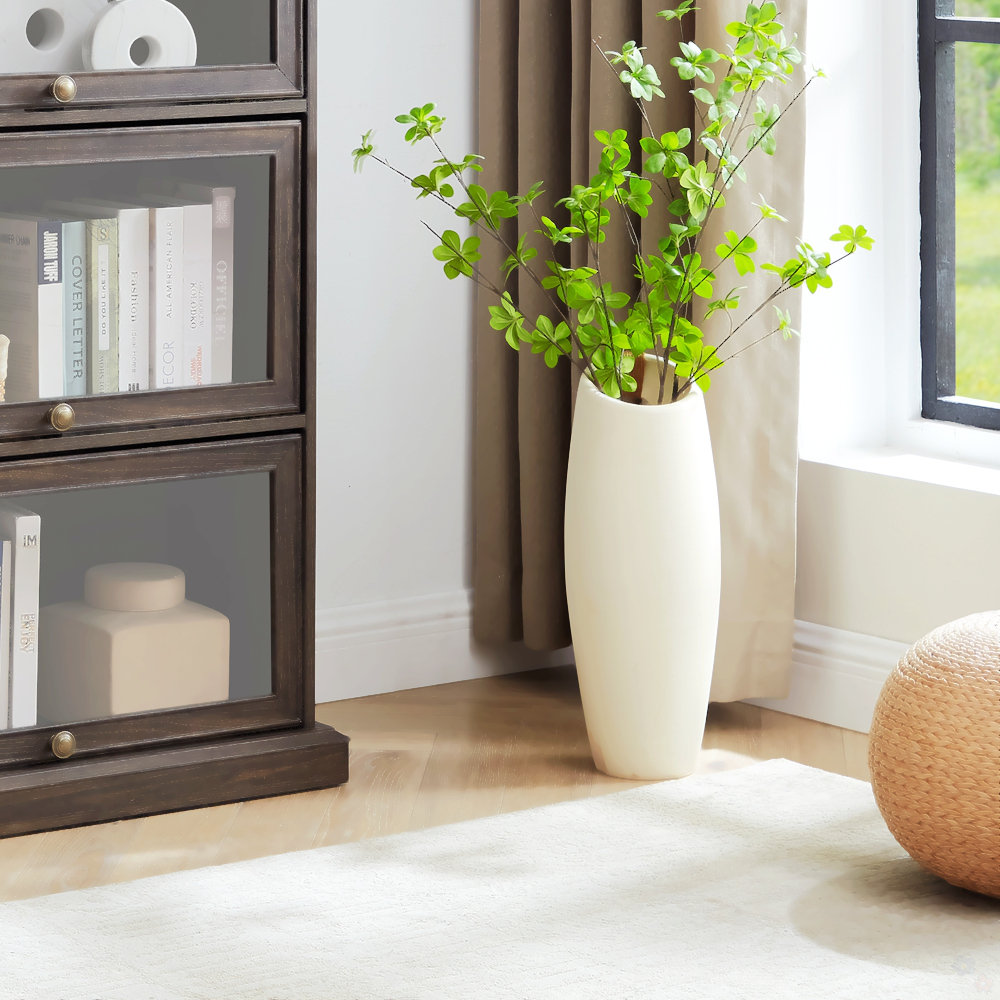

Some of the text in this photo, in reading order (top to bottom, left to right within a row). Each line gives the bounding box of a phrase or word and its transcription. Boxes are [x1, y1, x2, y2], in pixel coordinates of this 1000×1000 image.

[43, 231, 58, 282] JARON TUFF
[101, 268, 107, 277] IT
[72, 255, 83, 379] COVER LETTER
[130, 271, 139, 322] Fashion
[101, 322, 107, 335] DO
[163, 341, 174, 385] ECOR
